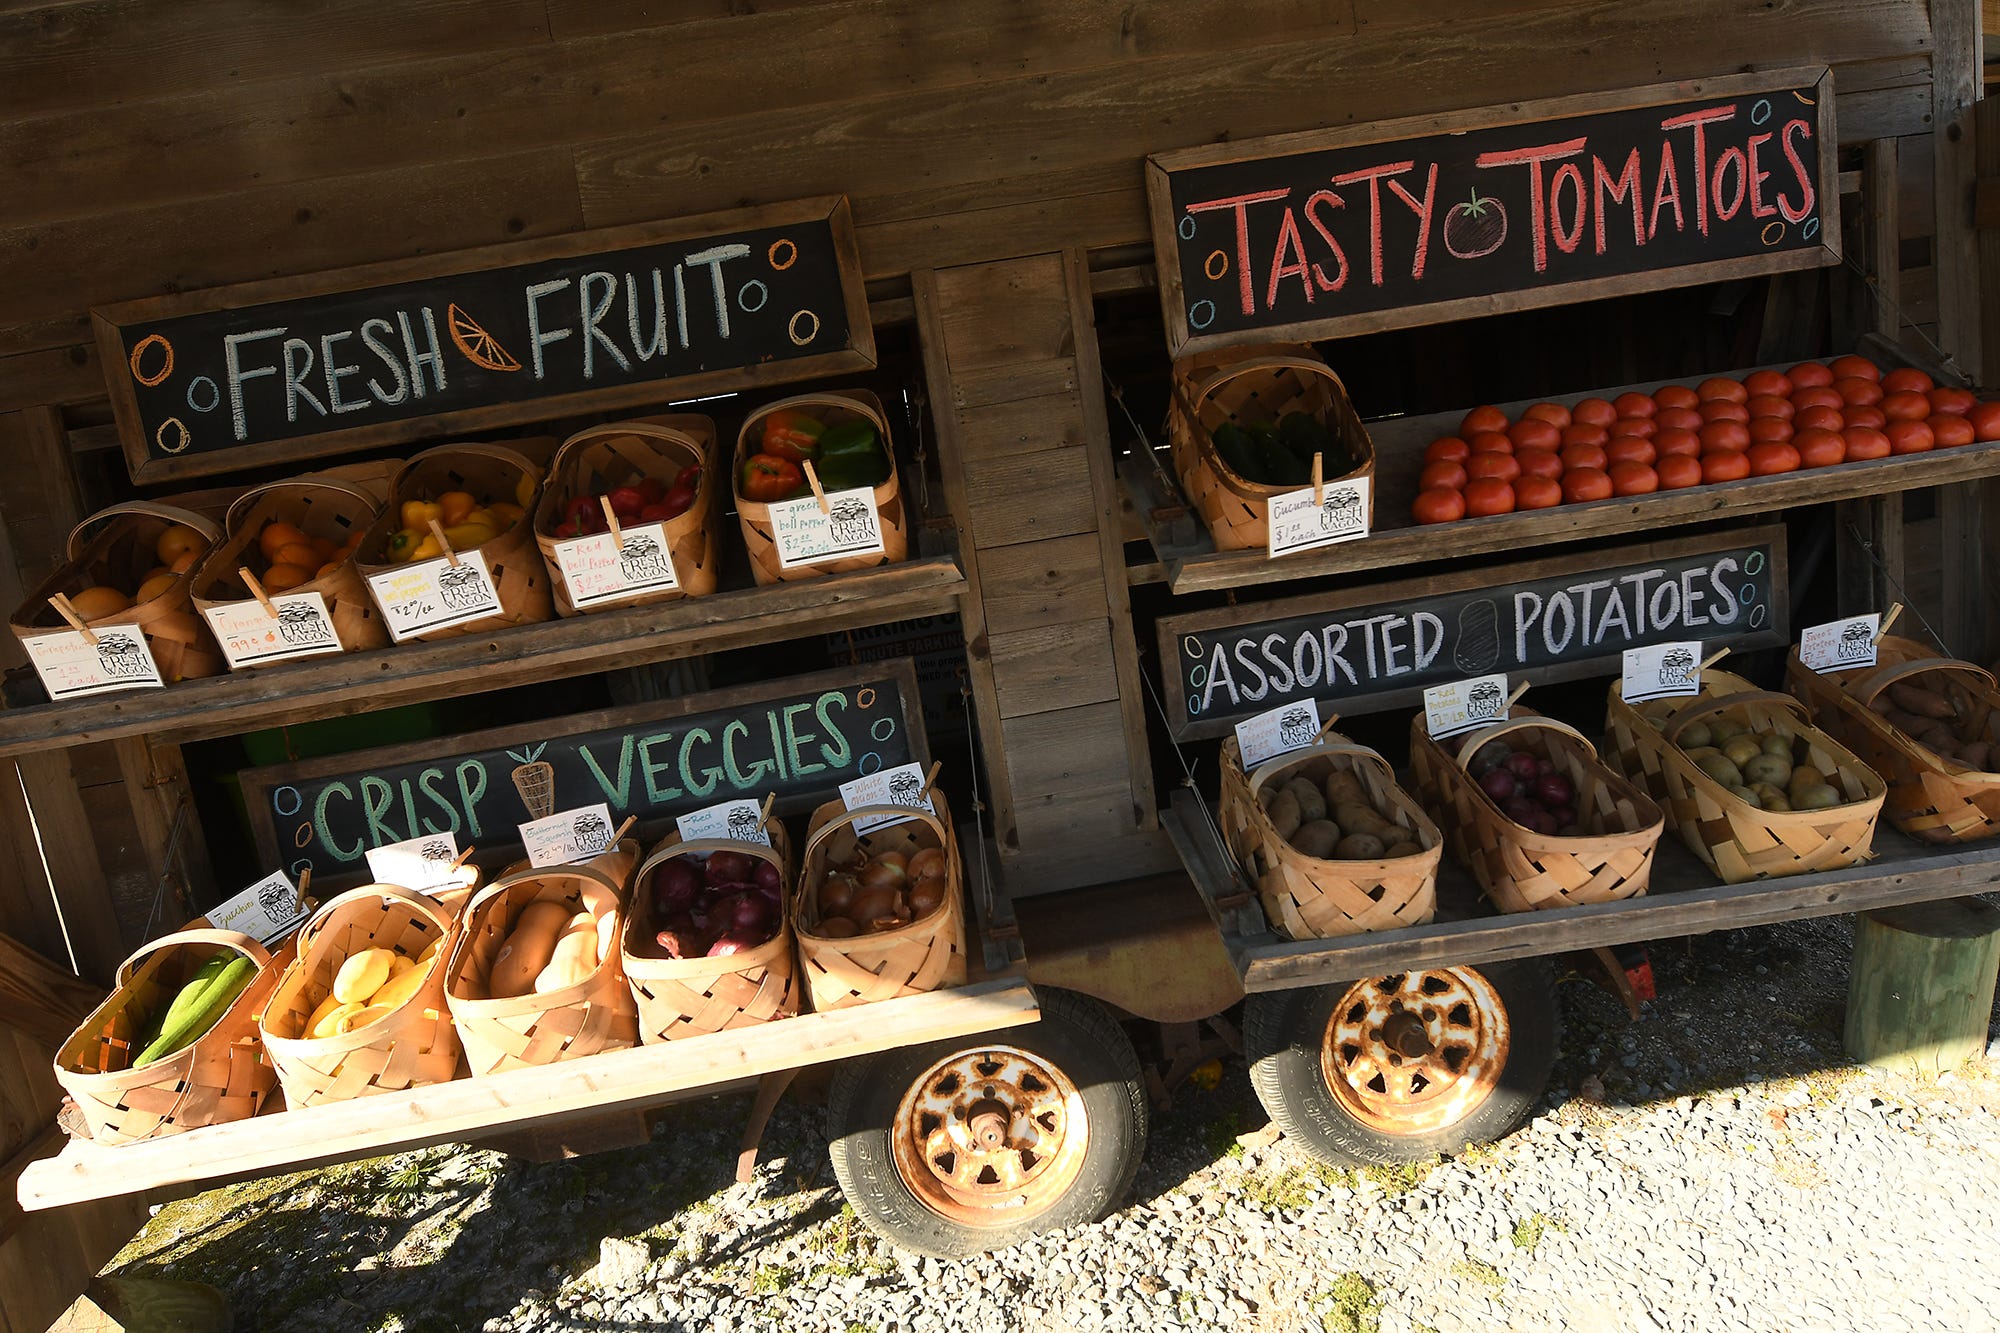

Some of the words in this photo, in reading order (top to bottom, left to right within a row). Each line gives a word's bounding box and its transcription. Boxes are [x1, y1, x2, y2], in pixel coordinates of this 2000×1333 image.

[1186, 161, 1438, 316] TASTY
[1476, 104, 1815, 273] TOMATOES
[225, 306, 447, 441] FRESH
[526, 243, 751, 381] FRUIT
[1320, 505, 1363, 525] FRESH
[830, 518, 875, 536] FRESH
[1320, 517, 1363, 531] WAGON
[832, 530, 876, 543] WAGON
[620, 554, 667, 573] FRESH
[623, 566, 669, 580] WAGON
[440, 580, 489, 601] FRESH
[444, 593, 492, 609] WAGON
[279, 620, 328, 636] FRESH
[1202, 611, 1444, 710] ASSORTED
[1514, 557, 1740, 663] POTATOES
[283, 632, 332, 643] WAGON
[1837, 647, 1873, 658] WAGON
[1838, 638, 1873, 655] FRESH
[99, 653, 149, 669] FRESH
[103, 666, 153, 676] WAGON
[1467, 698, 1504, 713] FRESH
[1280, 723, 1317, 741] FRESH
[314, 759, 488, 861] CRISP
[579, 691, 852, 811] VEGGIES
[574, 829, 612, 846] FRESH
